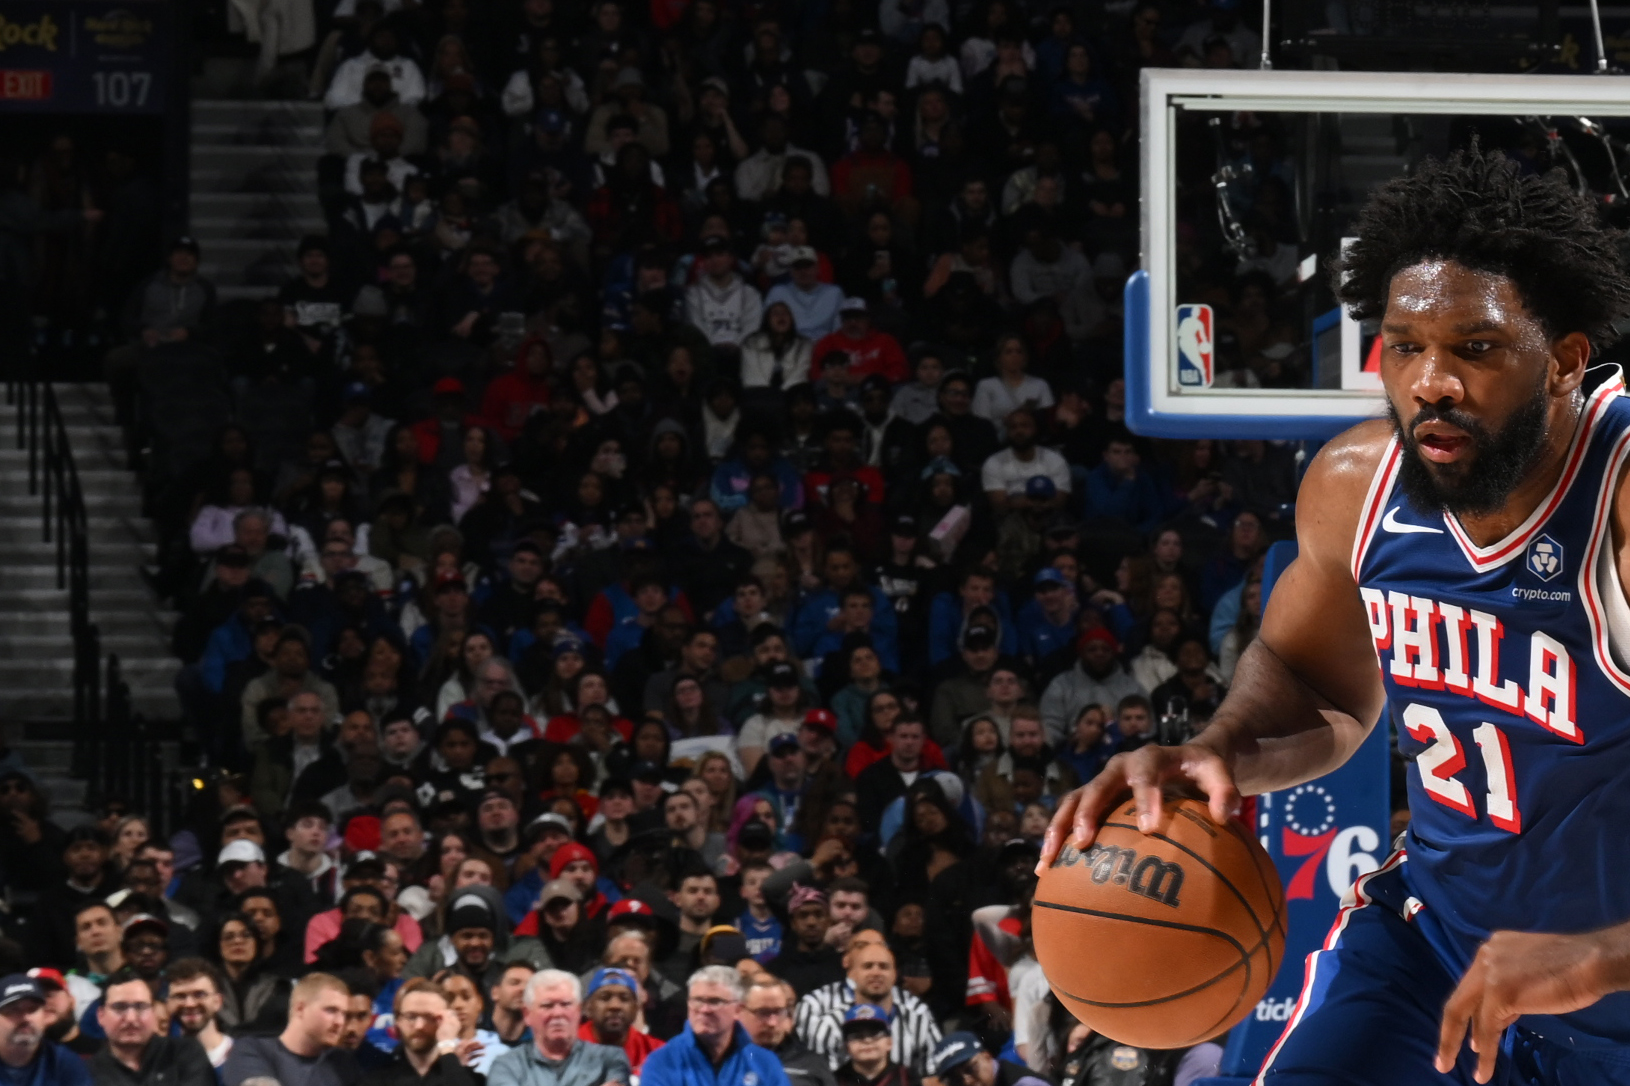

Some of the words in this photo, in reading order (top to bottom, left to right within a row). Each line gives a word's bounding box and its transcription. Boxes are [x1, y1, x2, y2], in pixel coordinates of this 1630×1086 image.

[4, 72, 43, 98] EXIT
[92, 72, 152, 107] 107
[1511, 586, 1571, 602] crypto.com
[1360, 586, 1585, 745] PHILA
[1403, 702, 1522, 835] 21
[1282, 825, 1380, 901] 76
